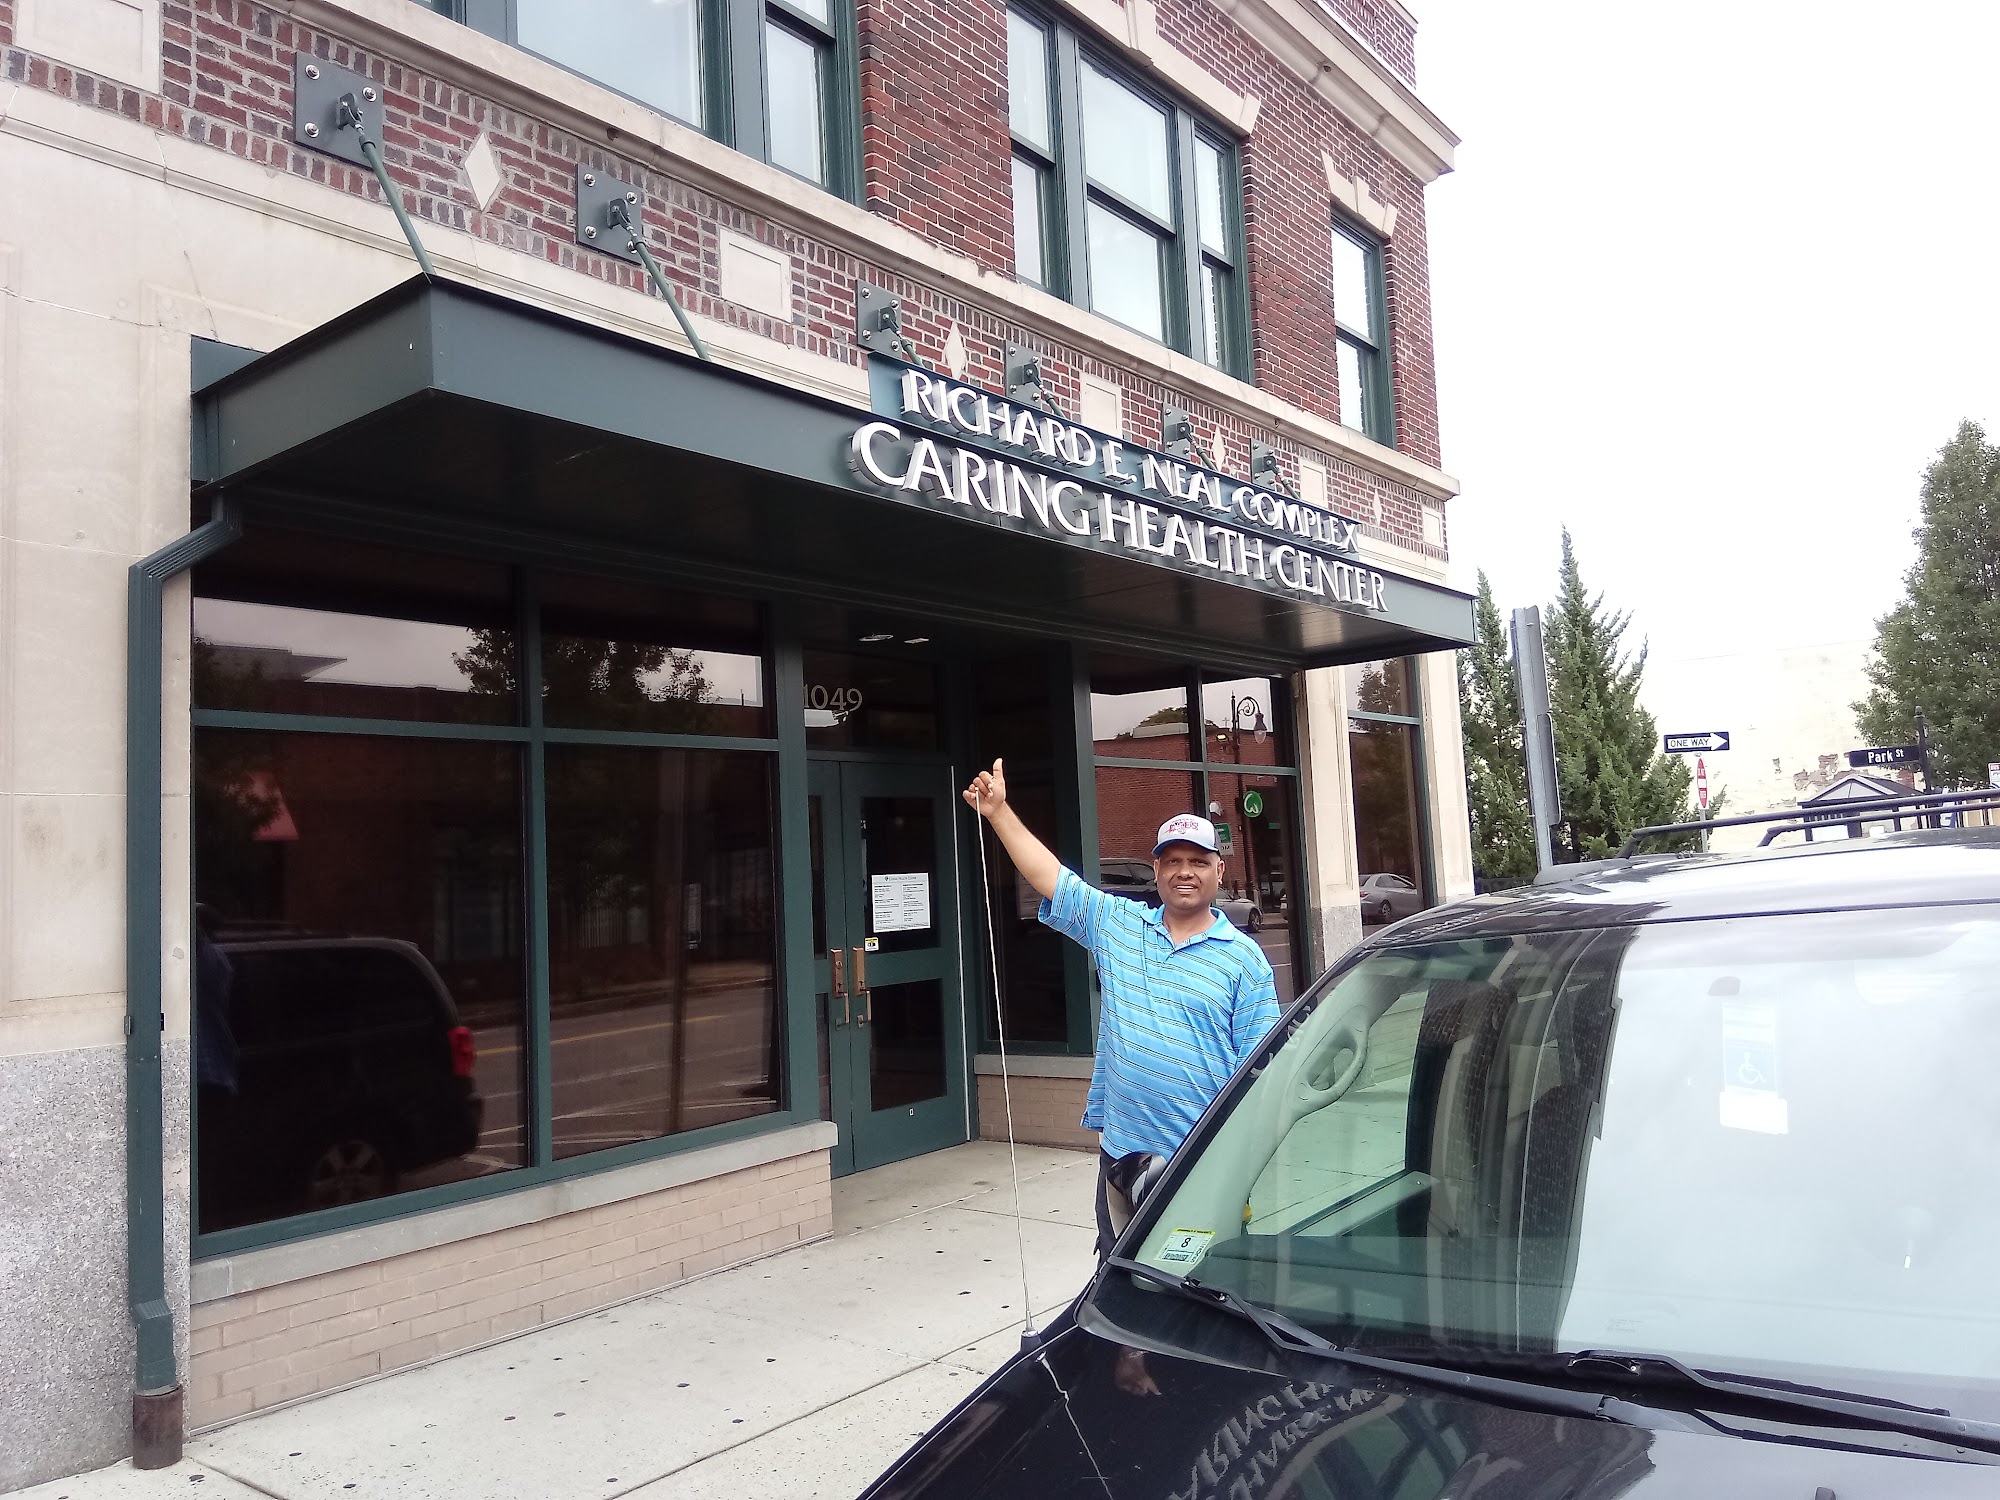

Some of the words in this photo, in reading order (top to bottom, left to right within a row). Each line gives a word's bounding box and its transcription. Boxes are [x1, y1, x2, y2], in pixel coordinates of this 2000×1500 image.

[901, 368, 1097, 468] RICHARD
[1103, 439, 1138, 485] E.
[1141, 453, 1232, 514] NEAL
[1232, 486, 1360, 553] COMPLEX
[851, 421, 1091, 536] CARING
[1095, 491, 1267, 581] HEALTH
[1269, 544, 1389, 612] CENTER
[803, 684, 863, 712] 1049
[1670, 739, 1688, 748] ONE
[1691, 738, 1709, 747] WAY
[1867, 750, 1894, 764] Park
[1895, 748, 1904, 758] St
[1181, 1237, 1192, 1248] 8
